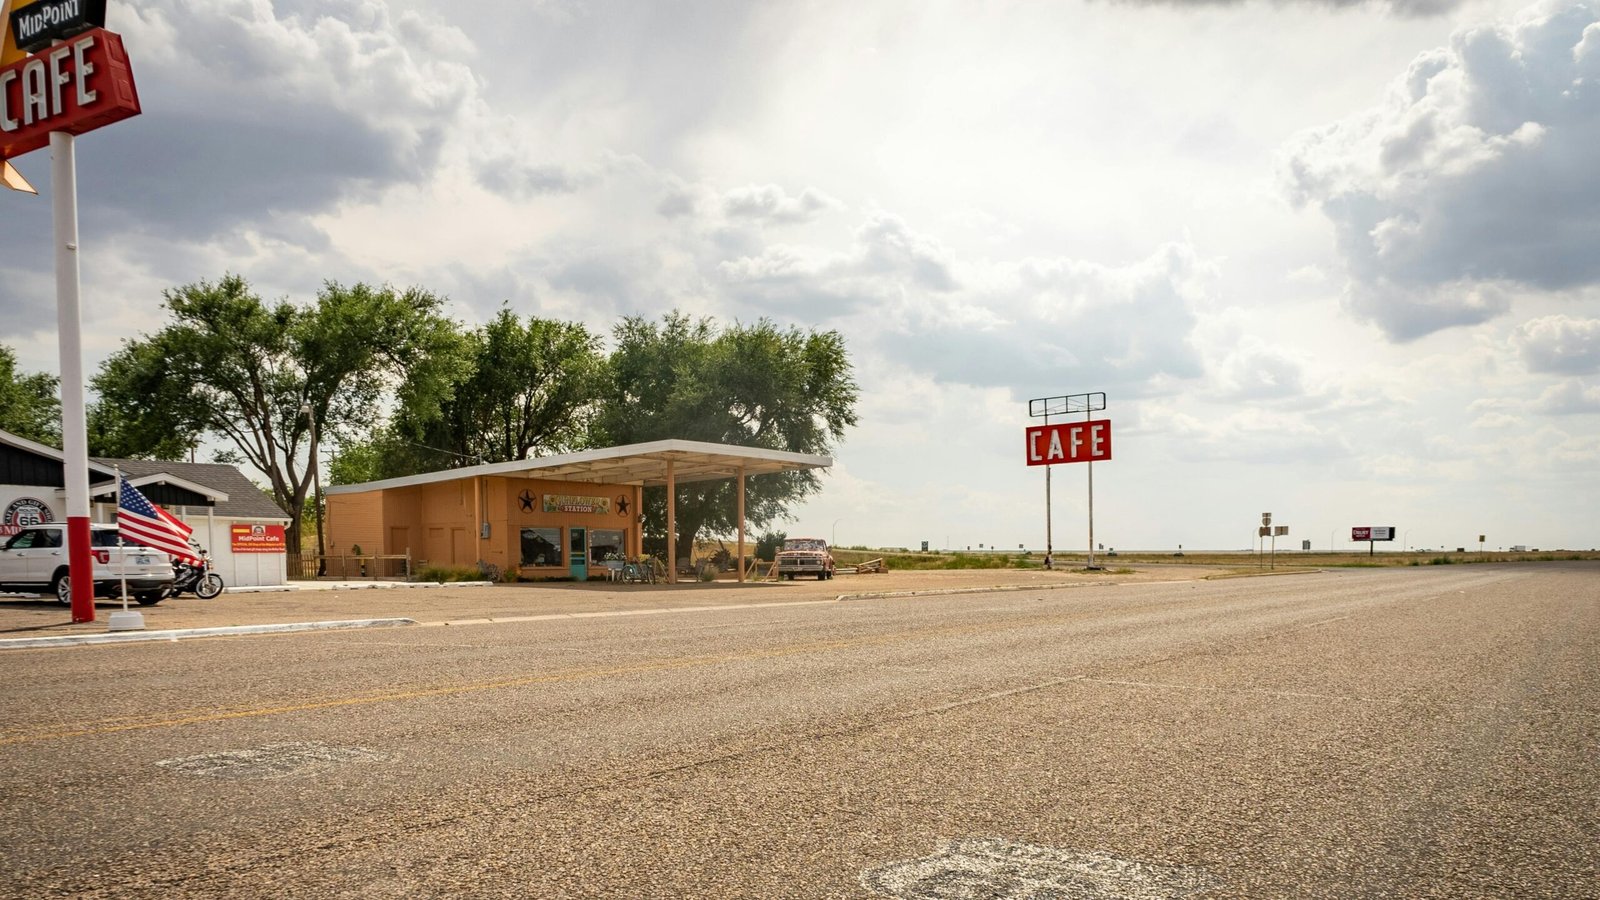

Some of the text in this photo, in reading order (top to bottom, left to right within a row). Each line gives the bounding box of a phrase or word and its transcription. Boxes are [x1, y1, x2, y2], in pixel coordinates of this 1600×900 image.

[0, 36, 97, 132] CAFE
[1030, 424, 1104, 462] CAFE
[13, 500, 27, 509] AND
[28, 500, 44, 509] GIFT
[564, 505, 592, 513] STATION
[20, 516, 38, 525] 66
